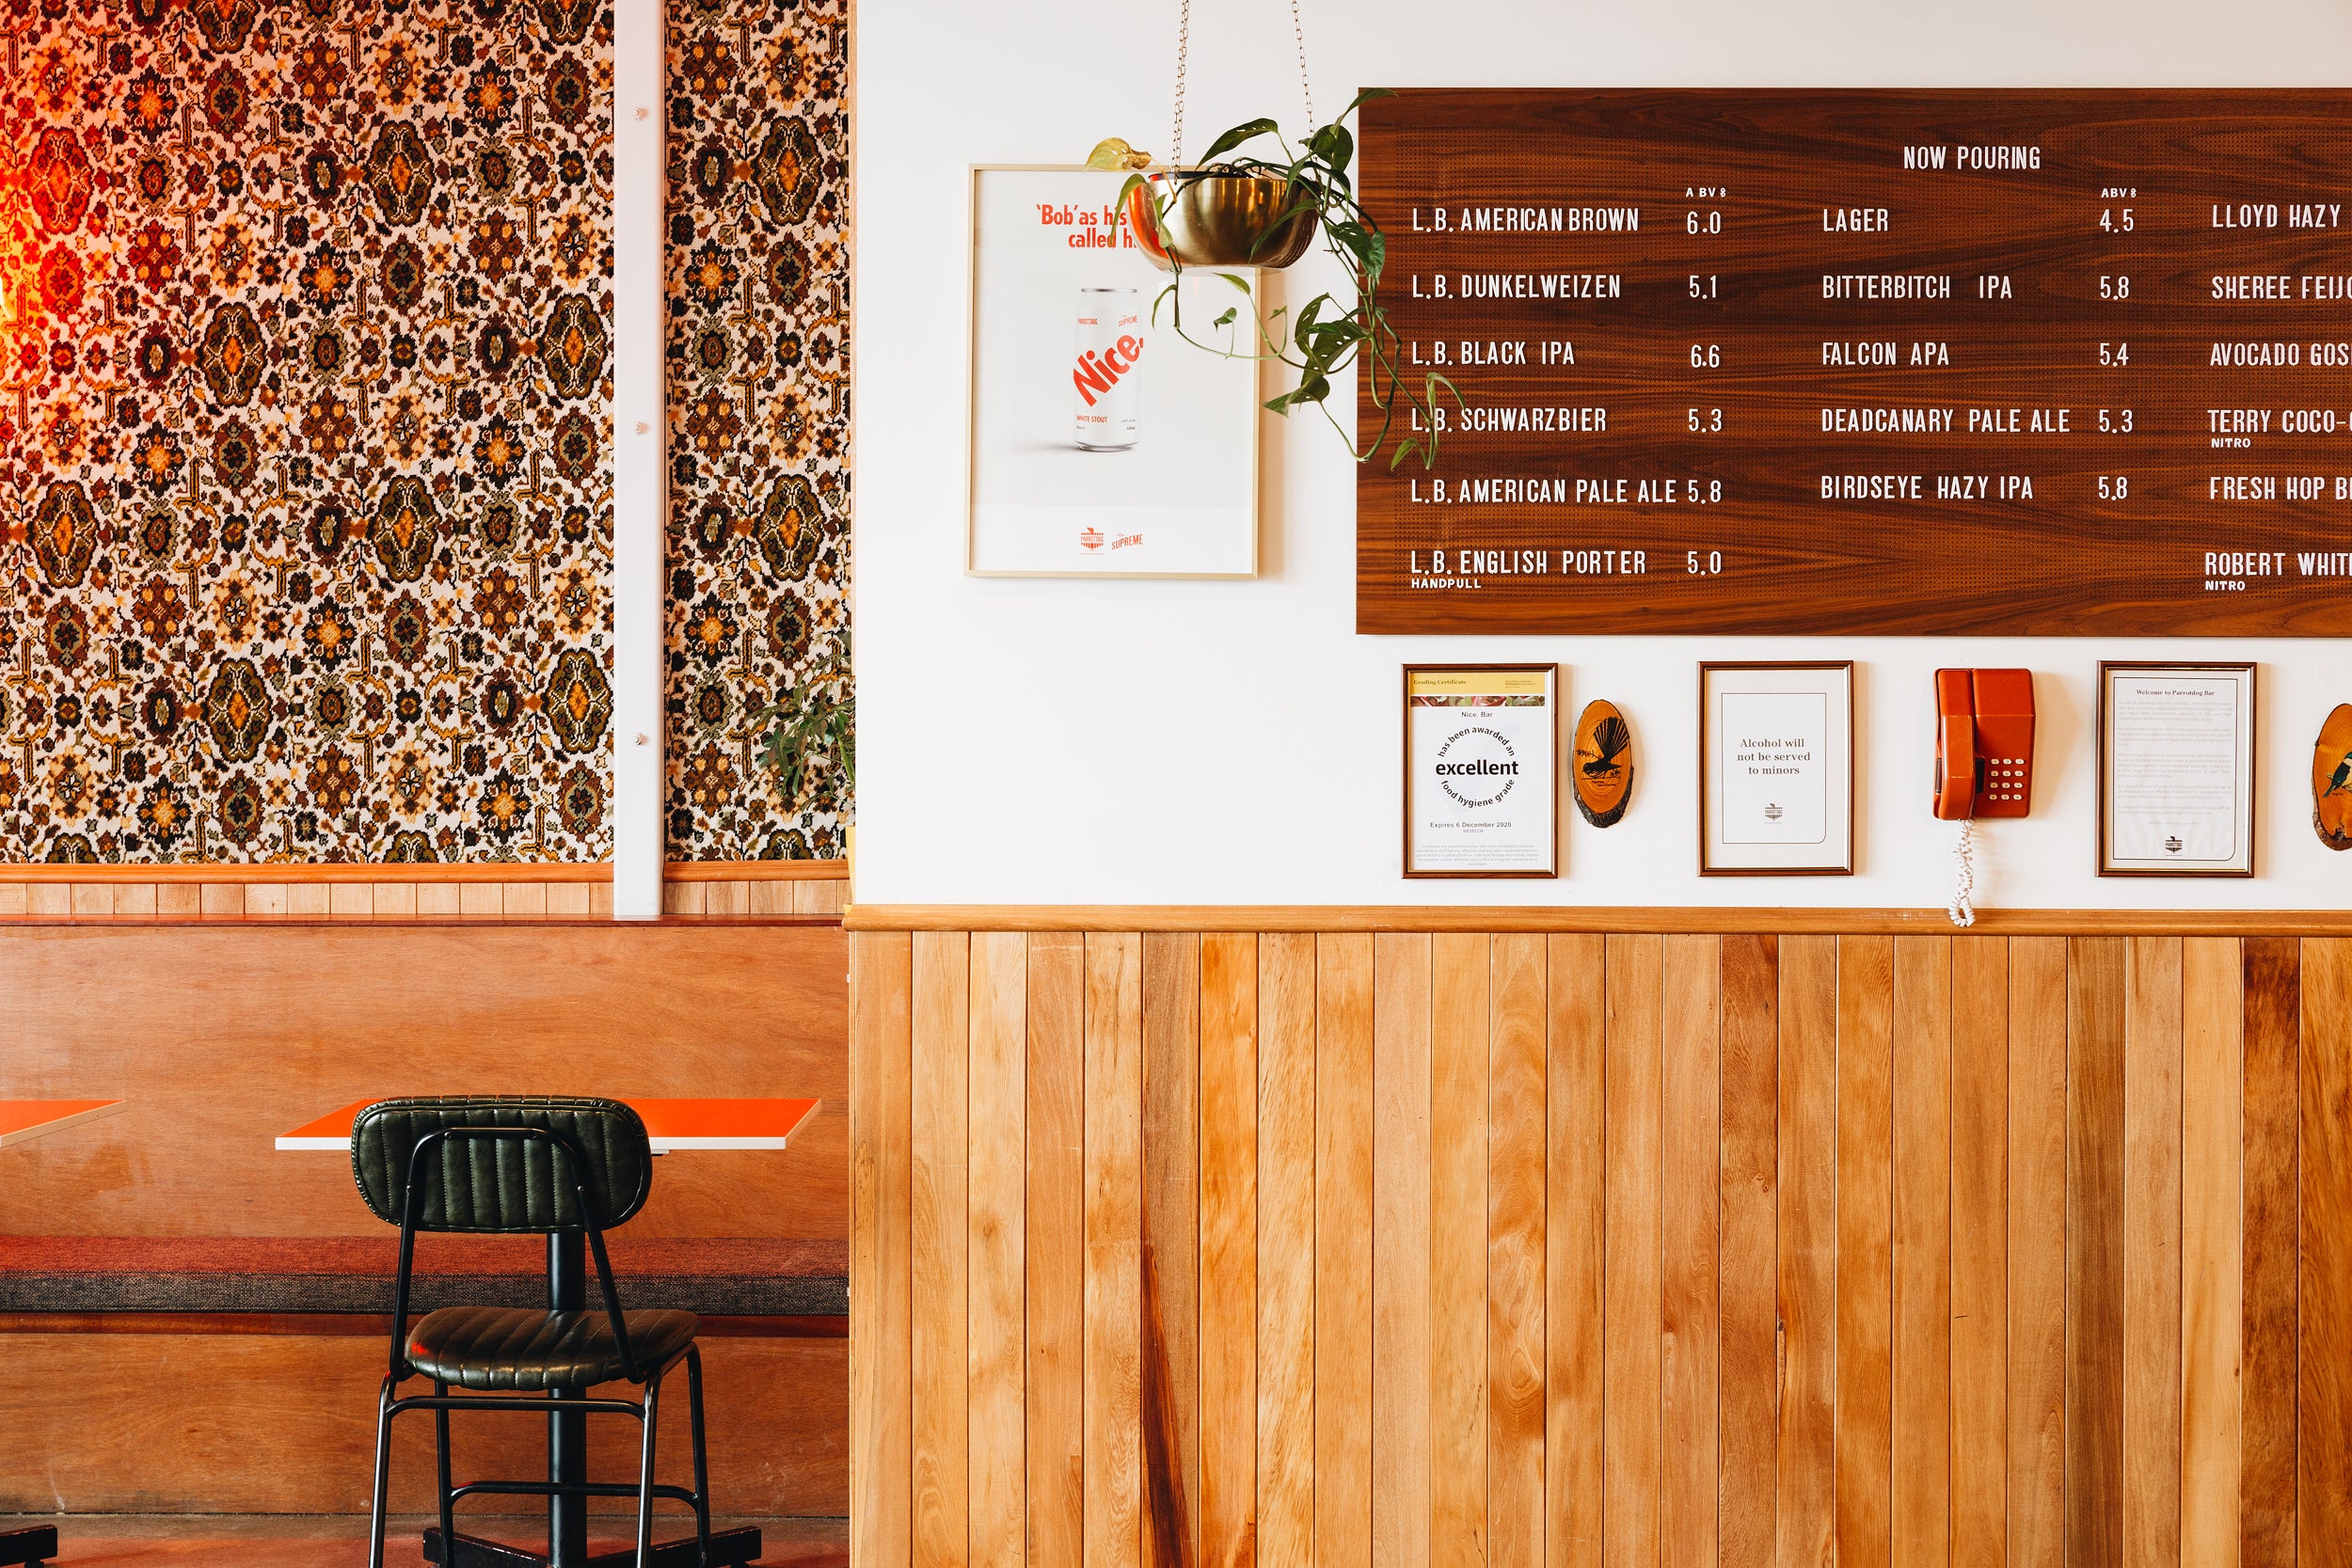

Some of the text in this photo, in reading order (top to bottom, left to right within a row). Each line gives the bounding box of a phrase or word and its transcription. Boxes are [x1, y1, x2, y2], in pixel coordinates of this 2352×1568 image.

[1903, 146, 2041, 170] NOW POURING
[1412, 207, 1721, 235] L.B. AMERICAN BROWN 6.0
[1823, 209, 2134, 233] LAGER 4.5
[2212, 204, 2341, 229] LLOYD HAZY
[1412, 274, 1717, 300] L.B. DUNKELWEIZEN 5.1
[1823, 276, 2129, 301] BITTERBITCH IPA 5.8
[2212, 276, 2291, 300] SHEREE
[1412, 341, 1720, 369] L.B. BLACK IPA 6.6
[1822, 341, 2129, 367] FALCON APA 5.4
[2210, 342, 2352, 367] AVOCADO GOS
[1461, 407, 1606, 432] SCHWARZBIER
[1688, 408, 1722, 434] 5.3
[1822, 408, 2133, 434] DEADCANARY PALE ALE 5.3
[2207, 409, 2272, 434] TERRY
[2211, 437, 2251, 449] NITRO
[1412, 479, 1722, 505] L.B. AMERICAN PALE ALE 5.8
[1821, 476, 2128, 501] BIRDSEYE HAZY IPA 5.8
[2210, 476, 2276, 500] FRESH
[2286, 476, 2326, 501] HOP
[1112, 533, 1144, 550] SUPREME
[1412, 550, 1722, 576] L.B. ENGLISH PORTER 5.0
[2206, 552, 2286, 577] ROBERT
[1411, 578, 1482, 589] HANDPULL
[2204, 580, 2246, 592] NITRO
[1438, 726, 1515, 757] has been awarded an
[1740, 738, 1804, 748] Alcohol will
[1436, 759, 1519, 776] excellent
[1737, 752, 1811, 762] not be served
[1748, 766, 1800, 775] to minors
[1440, 779, 1515, 809] food hygiene grade
